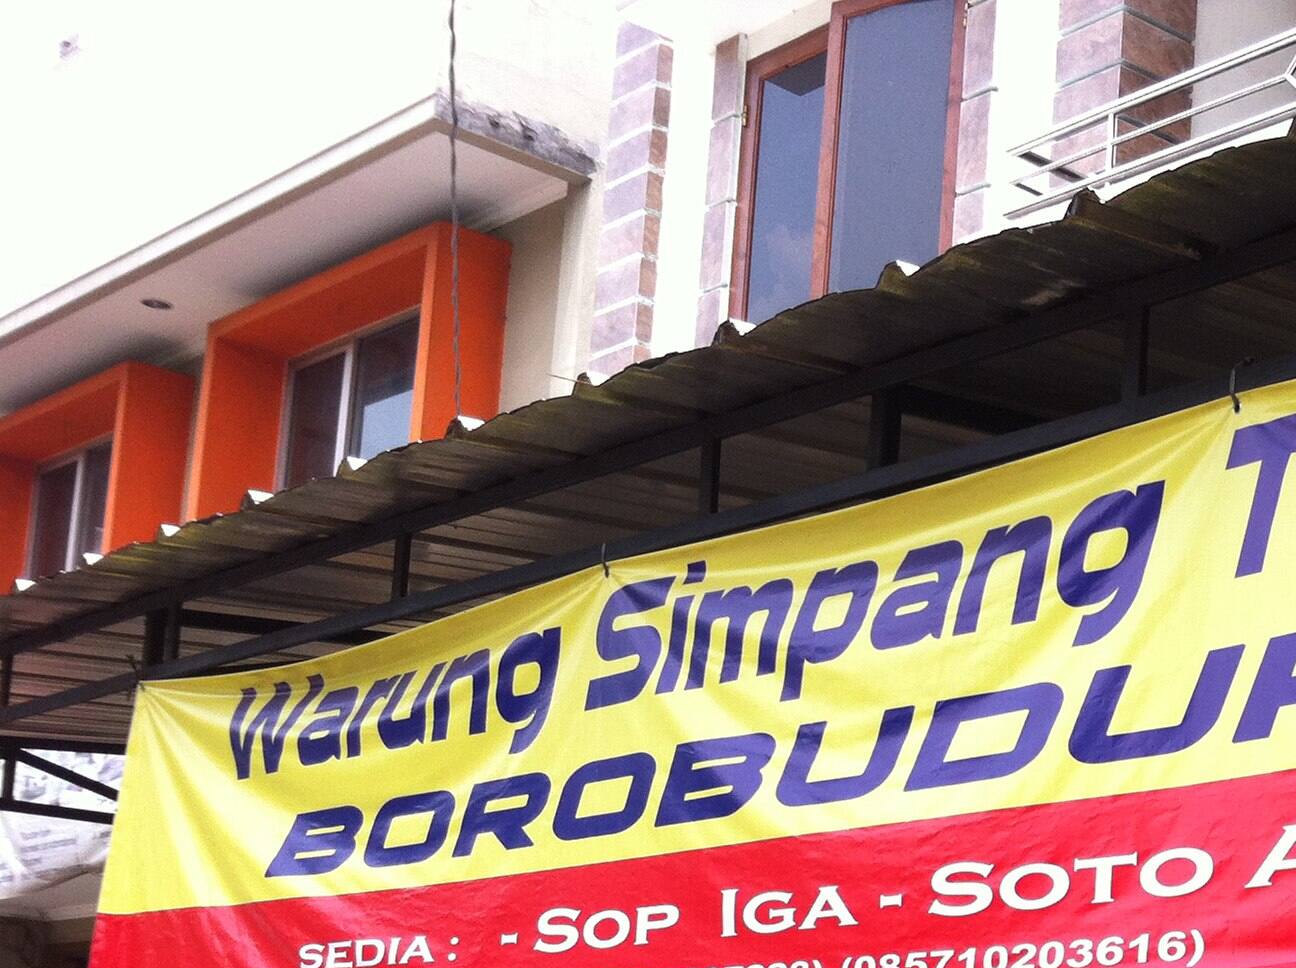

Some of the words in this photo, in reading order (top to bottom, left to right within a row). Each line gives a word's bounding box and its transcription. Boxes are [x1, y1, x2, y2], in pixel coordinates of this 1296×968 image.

[228, 625, 562, 779] Warung
[586, 479, 1165, 711] Simpang
[533, 903, 681, 954] SOP
[720, 885, 860, 938] IGA
[927, 847, 1215, 918] SOTO
